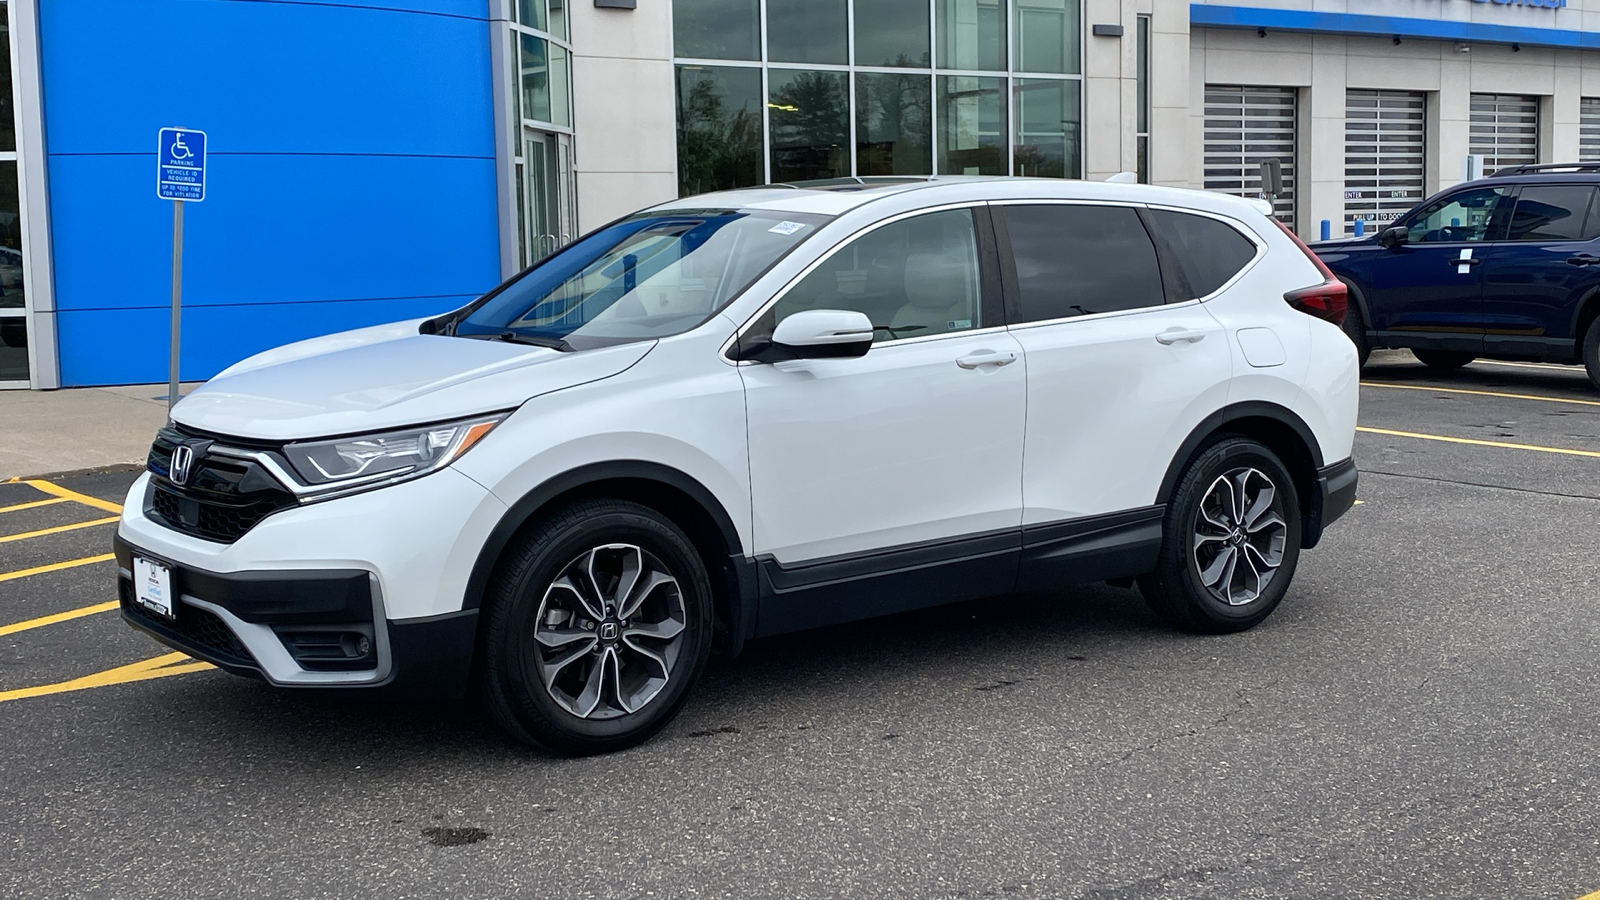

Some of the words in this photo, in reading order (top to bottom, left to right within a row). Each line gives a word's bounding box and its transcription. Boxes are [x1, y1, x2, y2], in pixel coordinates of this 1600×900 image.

[1345, 191, 1362, 199] ENTER
[1391, 190, 1408, 198] ENTER
[1366, 213, 1375, 221] UP
